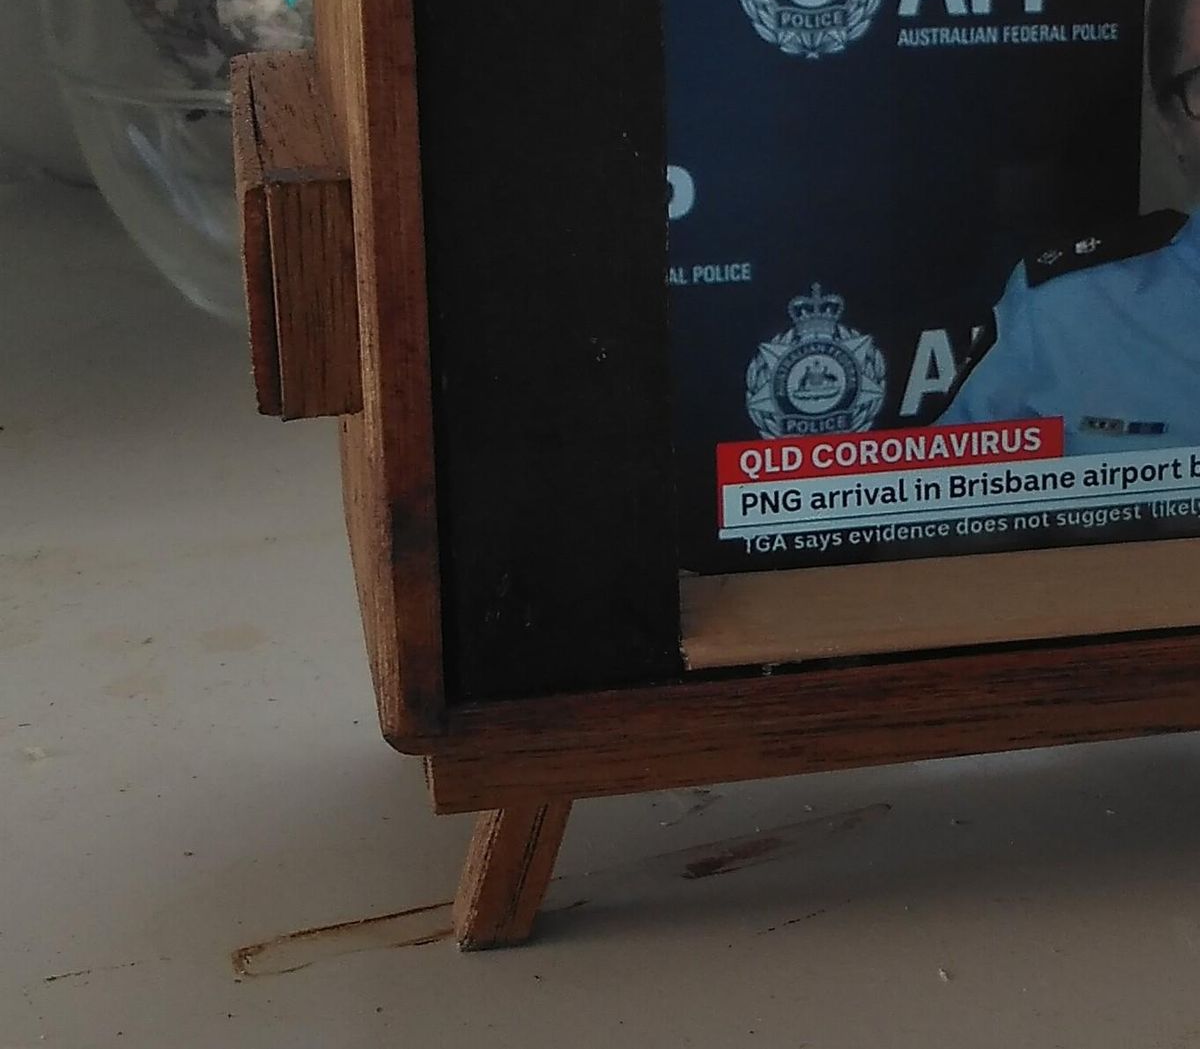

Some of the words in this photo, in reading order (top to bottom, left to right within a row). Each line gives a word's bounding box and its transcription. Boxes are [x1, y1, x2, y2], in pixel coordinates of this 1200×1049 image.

[780, 12, 843, 27] POLICE
[897, 27, 998, 47] AUSTRALIAN
[1002, 25, 1067, 44] FEDERAL
[1071, 22, 1119, 41] POLICE
[693, 263, 752, 283] POLICE
[786, 418, 845, 433] POLICE
[739, 447, 802, 480] QLD
[812, 426, 1042, 470] CORONAVIRUS
[740, 490, 801, 516] PNG
[810, 480, 907, 510] arrival
[914, 477, 941, 501] in
[949, 471, 1076, 499] Brisbane
[1082, 458, 1182, 489] airport
[794, 529, 842, 553] says
[848, 520, 950, 546] evidence
[956, 516, 1008, 538] does
[1013, 513, 1050, 532] not
[1056, 505, 1142, 528] suggest
